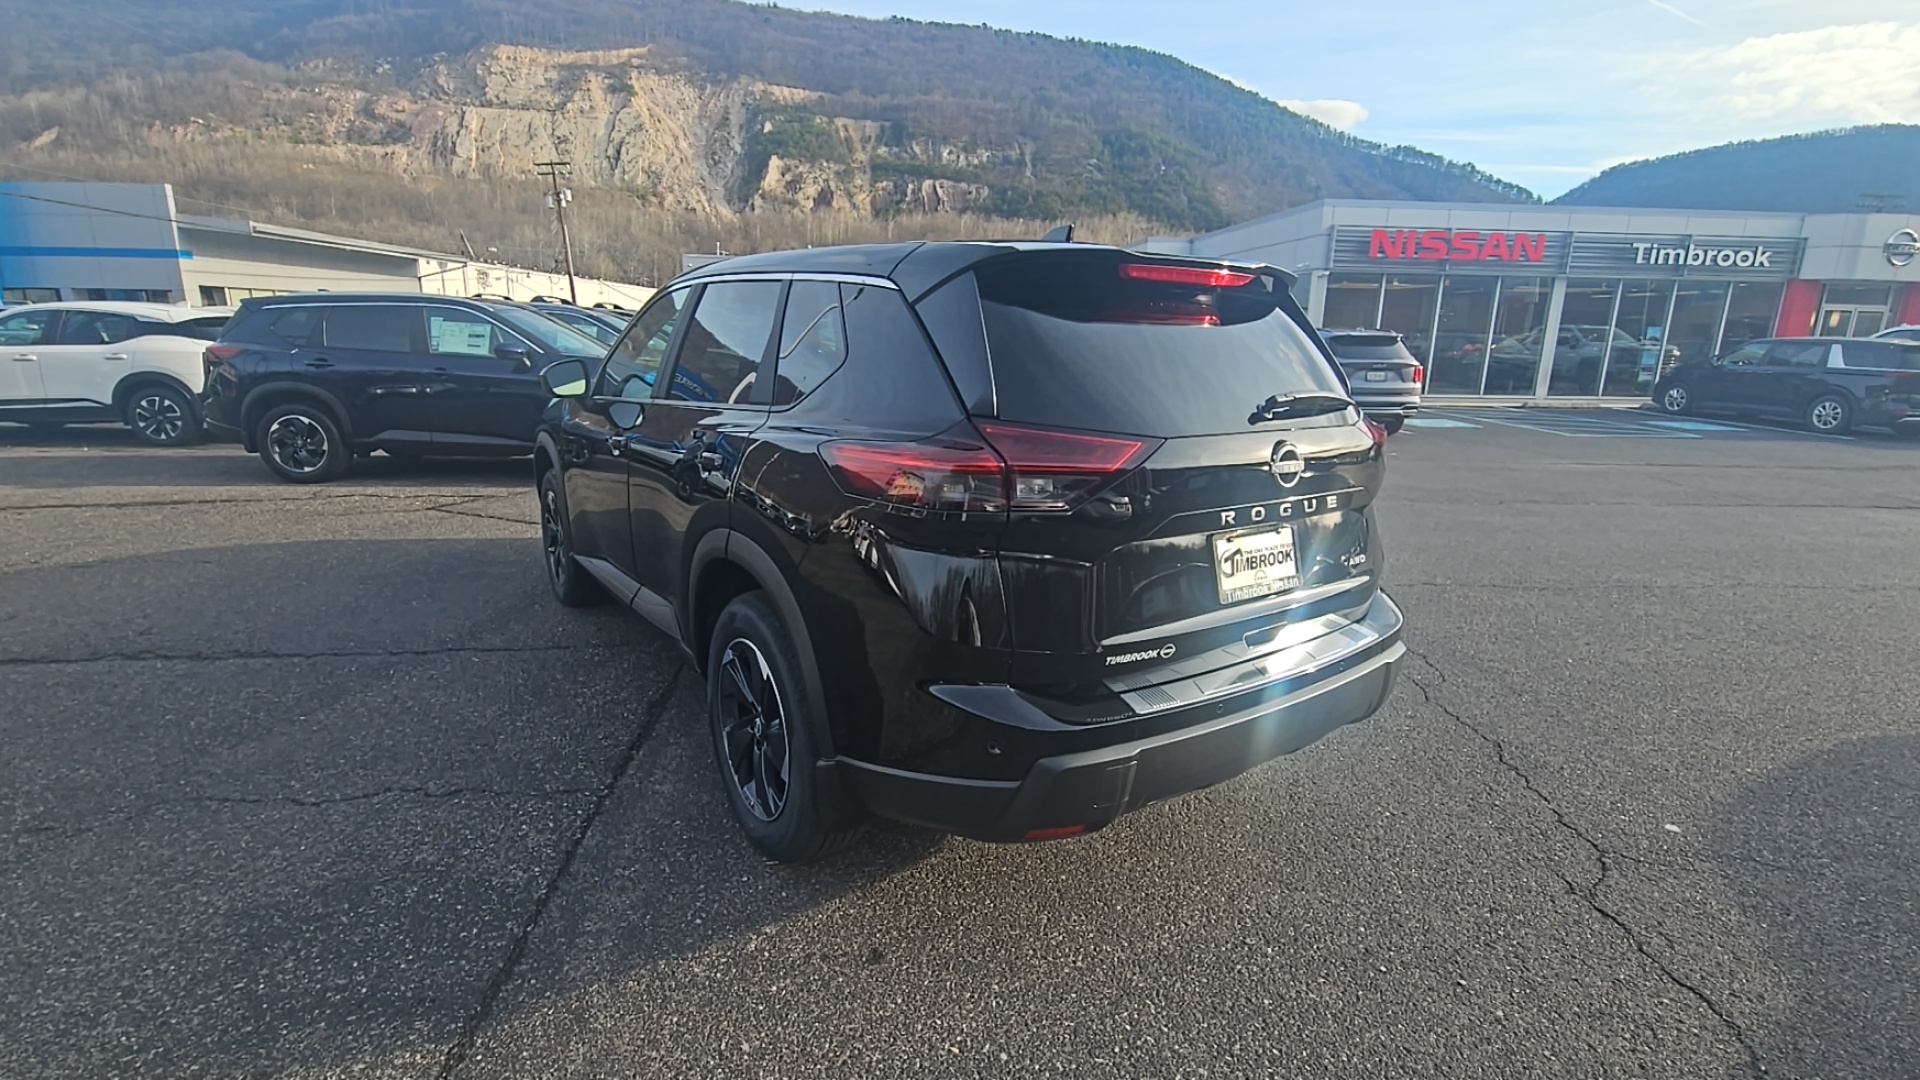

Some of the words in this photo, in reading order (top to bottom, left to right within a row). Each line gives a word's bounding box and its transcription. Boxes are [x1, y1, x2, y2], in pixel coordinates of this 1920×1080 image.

[1369, 228, 1546, 263] NISSAN
[1632, 242, 1773, 267] Timbrook
[1220, 495, 1338, 526] ROGUE
[1221, 547, 1293, 577] TIMBROOK
[1226, 584, 1268, 603] Timbrook
[1105, 648, 1160, 666] TIMBROOK
